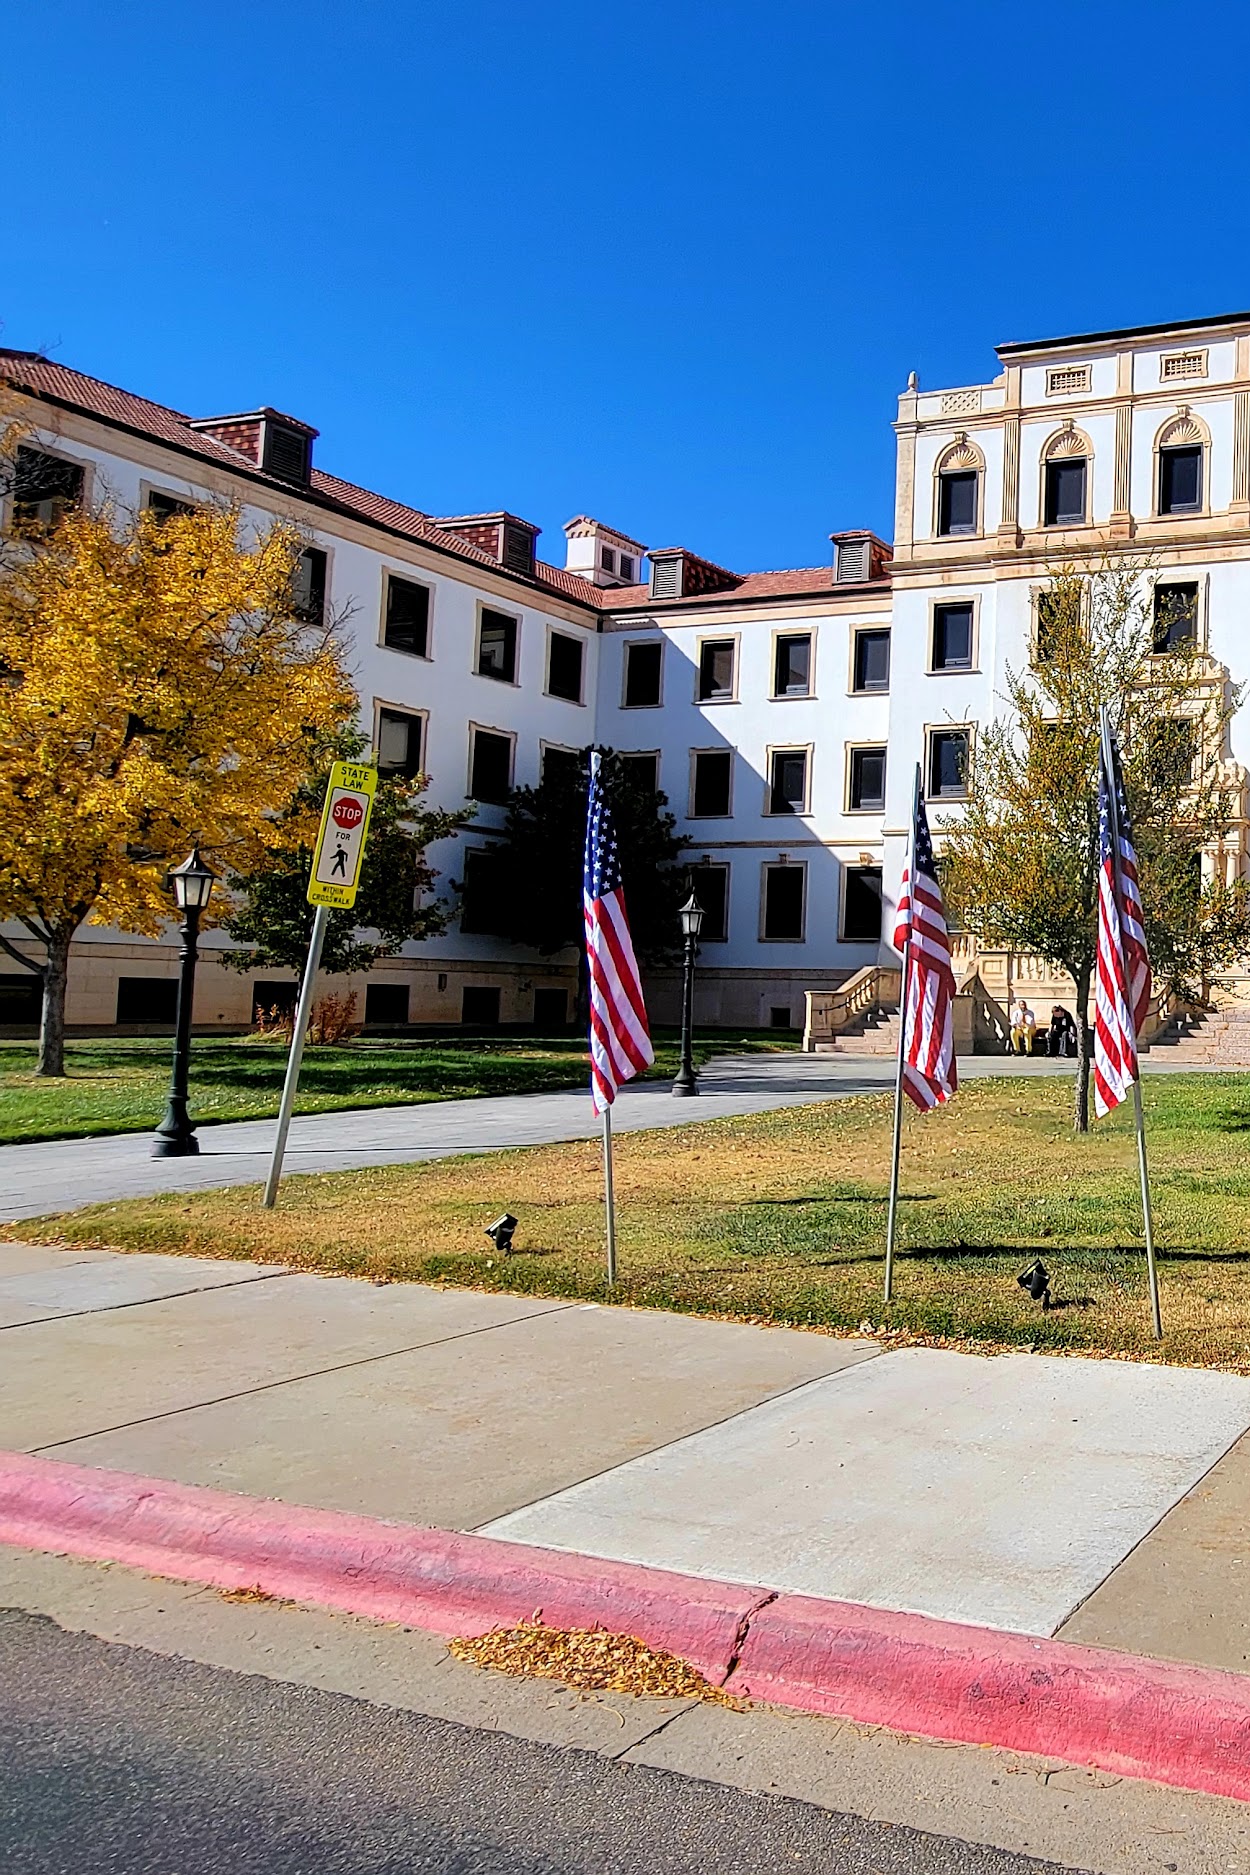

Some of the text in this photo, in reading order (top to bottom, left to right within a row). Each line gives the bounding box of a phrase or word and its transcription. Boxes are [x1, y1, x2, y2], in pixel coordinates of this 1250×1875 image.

[341, 766, 370, 781] STATE
[343, 779, 364, 790] LAW
[334, 805, 362, 821] STOP
[335, 831, 351, 841] FOR
[322, 886, 344, 895] WITHIN
